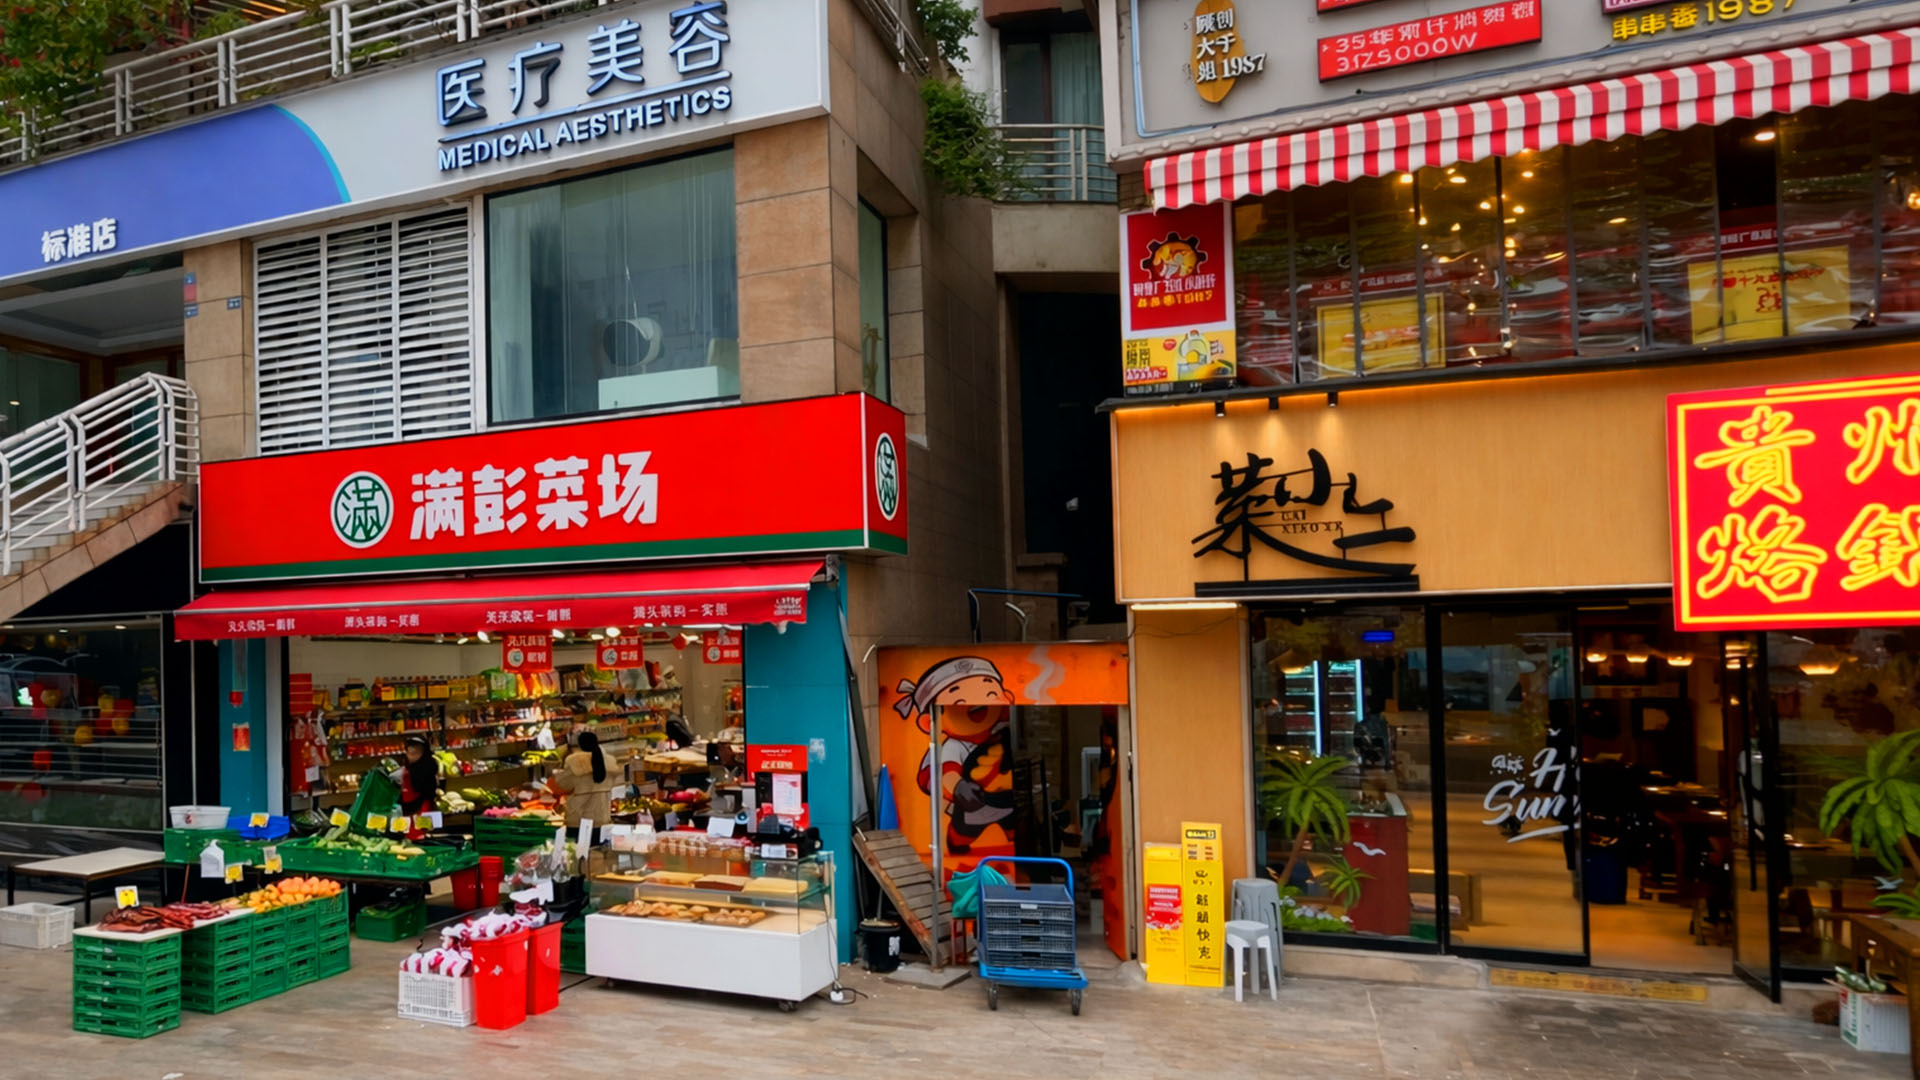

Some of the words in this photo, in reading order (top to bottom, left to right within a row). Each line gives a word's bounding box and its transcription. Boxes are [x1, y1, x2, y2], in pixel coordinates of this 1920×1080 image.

[437, 0, 731, 126] 医疗美容
[438, 127, 550, 171] MEDICAL
[556, 85, 732, 146] AESTHETICS
[41, 217, 117, 263] 标准店
[409, 450, 659, 541] 满彭菜场
